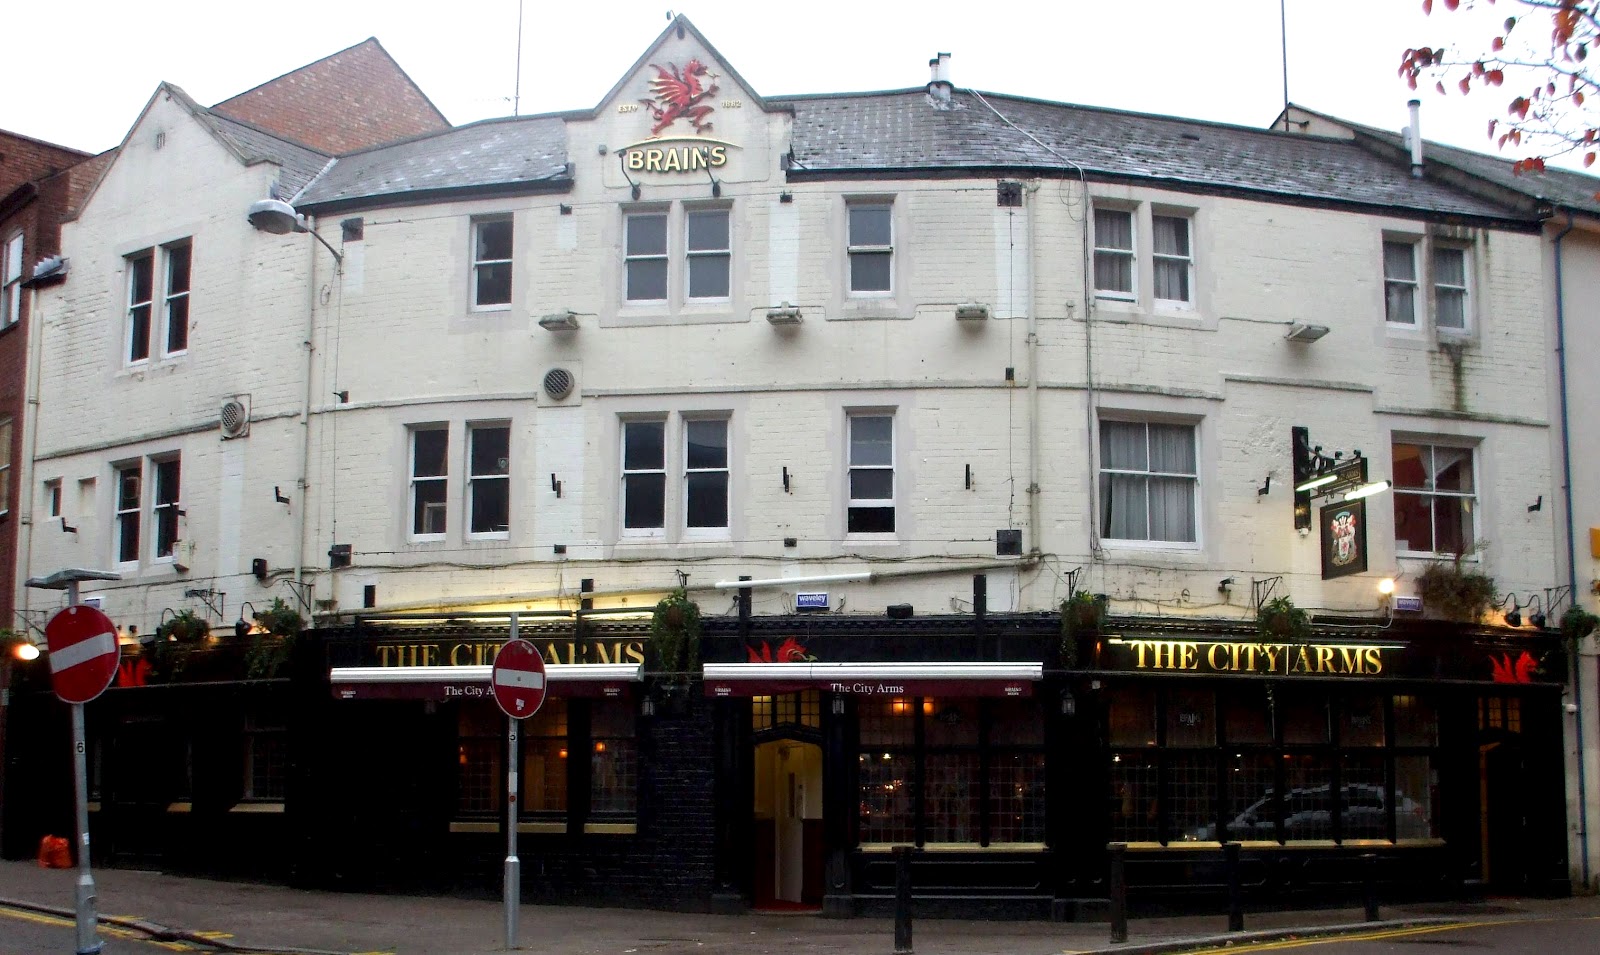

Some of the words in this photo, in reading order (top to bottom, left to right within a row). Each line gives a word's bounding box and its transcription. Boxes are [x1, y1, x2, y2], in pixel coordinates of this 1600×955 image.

[799, 594, 826, 603] waveley
[376, 644, 440, 667] THE
[450, 643, 505, 666] CIT
[543, 642, 644, 665] ARMS
[1131, 641, 1199, 670] THE
[1208, 643, 1285, 672] CITY
[1291, 645, 1383, 675] ARMS
[443, 685, 463, 696] The
[464, 685, 485, 698] City
[830, 683, 851, 693] The
[852, 683, 875, 695] City
[876, 683, 904, 693] Arms
[77, 742, 84, 753] 6
